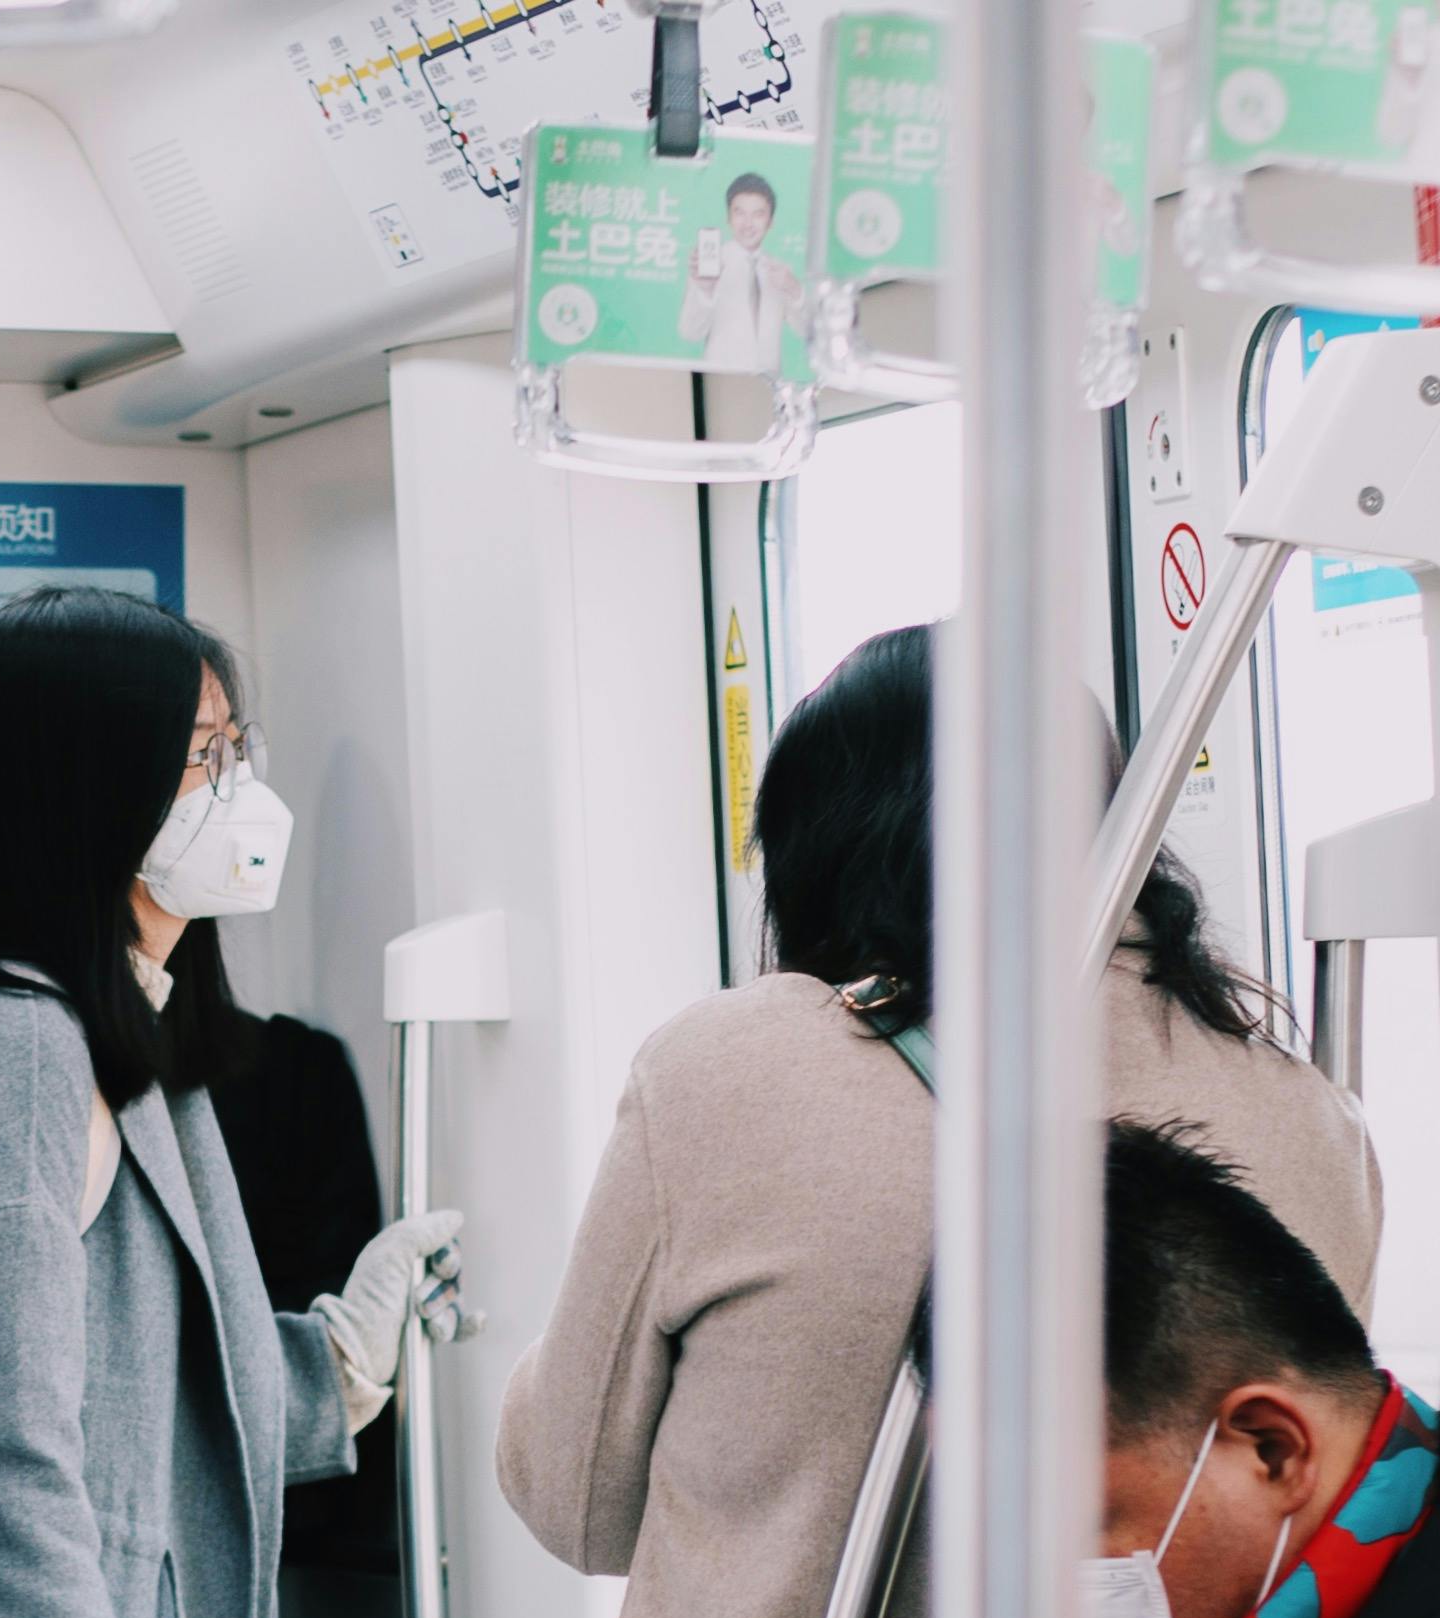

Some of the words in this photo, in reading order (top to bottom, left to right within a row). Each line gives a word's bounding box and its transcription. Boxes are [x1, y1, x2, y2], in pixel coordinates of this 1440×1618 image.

[543, 180, 680, 224] 装修就上
[541, 219, 679, 268] 土巴兔
